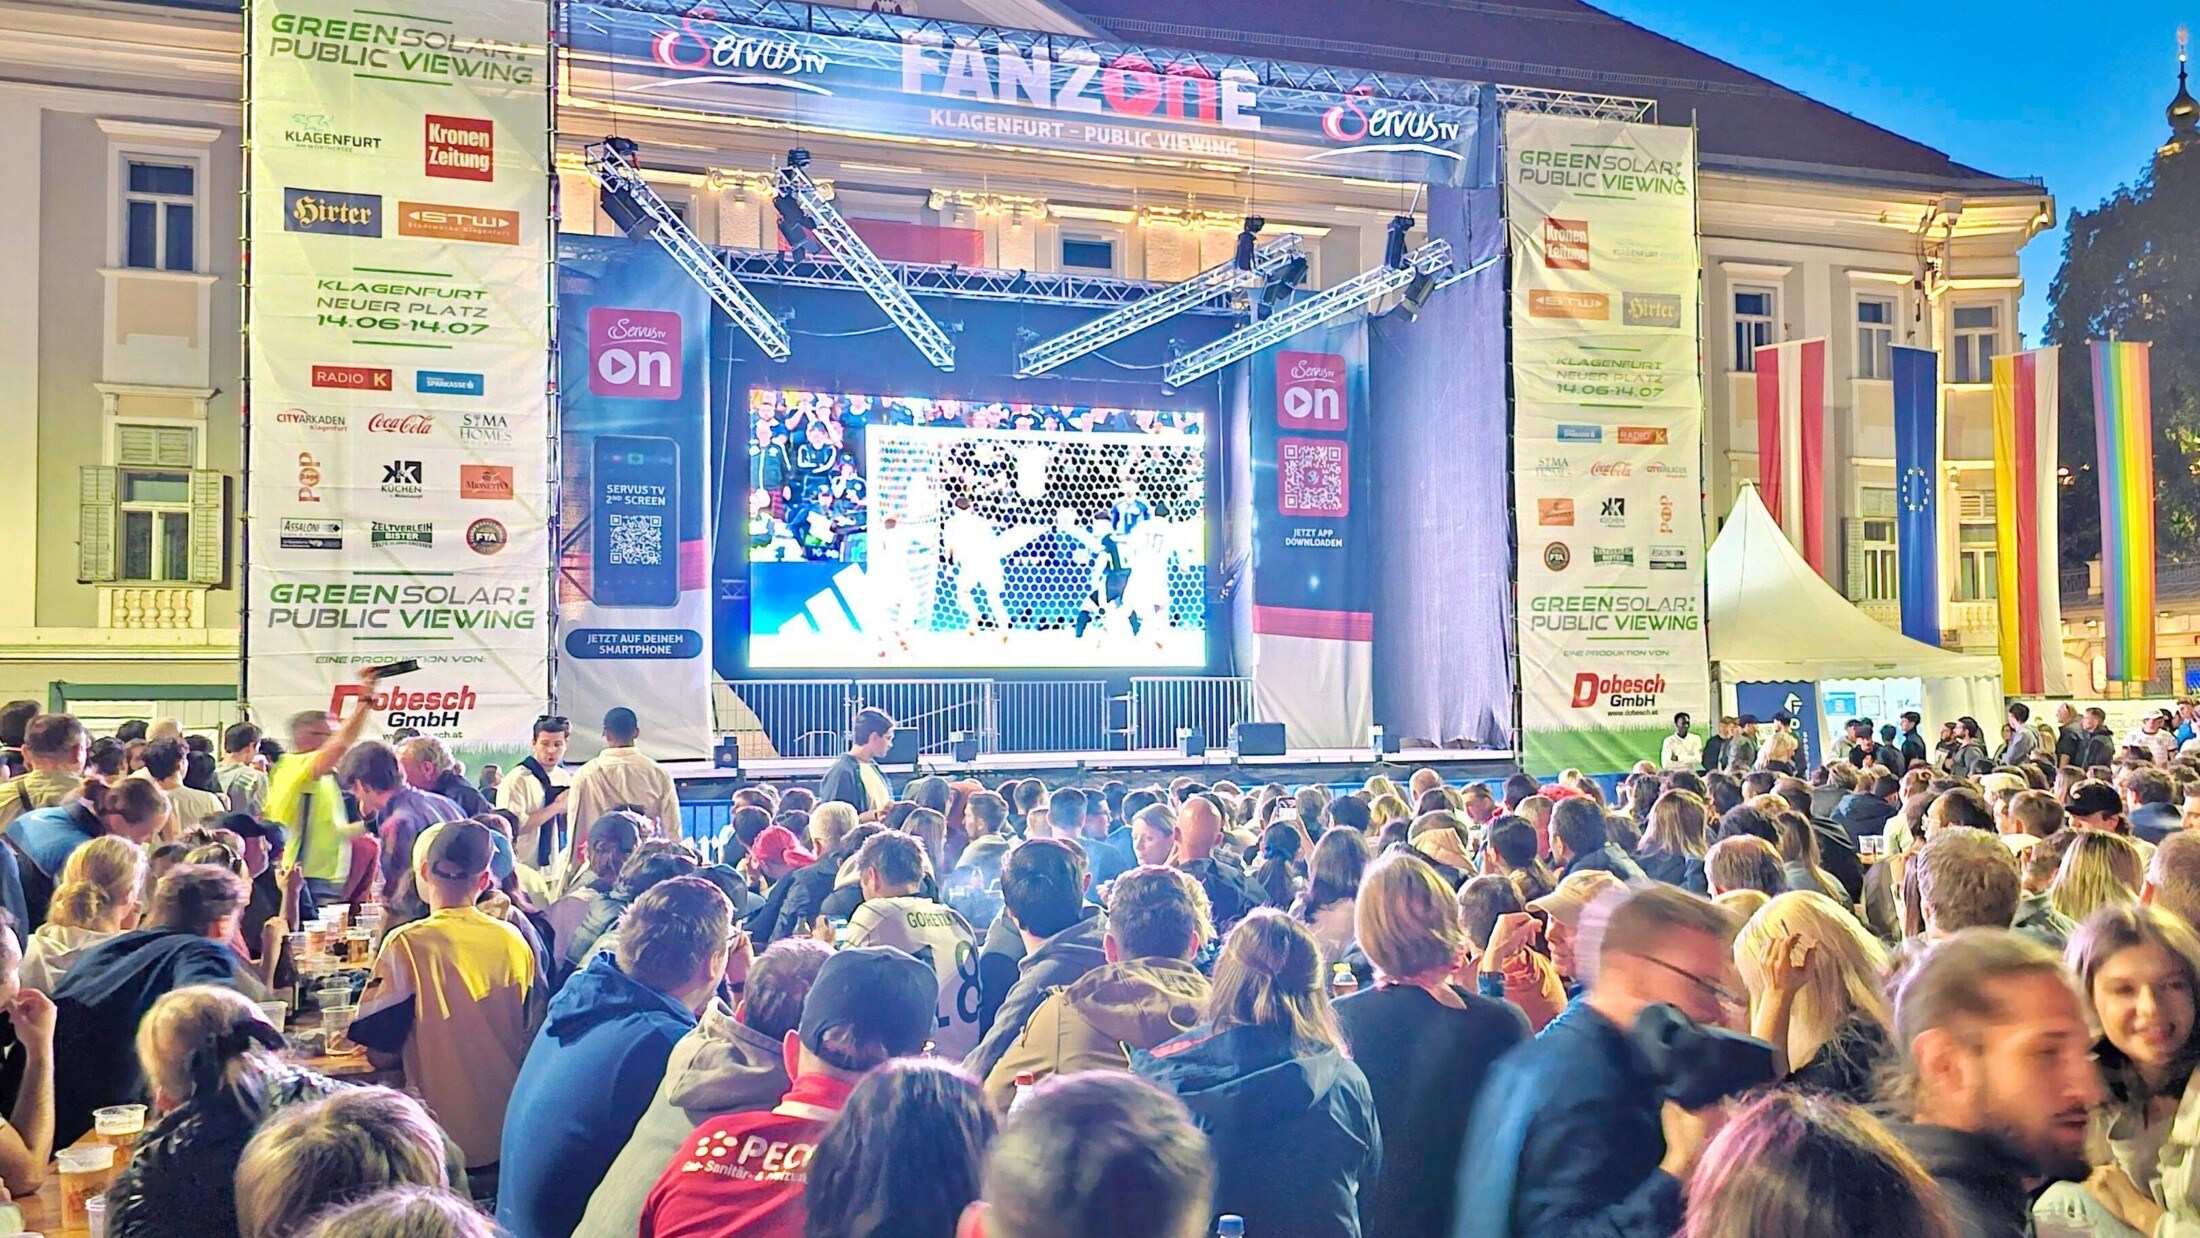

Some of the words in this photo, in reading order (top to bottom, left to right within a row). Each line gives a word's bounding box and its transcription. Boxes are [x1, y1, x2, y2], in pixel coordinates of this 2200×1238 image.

[269, 37, 390, 69] PUBLIC
[398, 51, 534, 85] VIEWING
[285, 130, 382, 149] KLAGENFURT
[429, 123, 490, 149] Kronen
[929, 108, 1064, 140] KLAGENFURT
[1084, 125, 1151, 149] PUBLIC
[1156, 133, 1239, 158] VIEWING
[429, 147, 490, 173] Zeitung
[1519, 168, 1597, 189] PUBLIC
[1601, 172, 1687, 196] VIEWING
[293, 194, 373, 228] Hirter
[1546, 224, 1586, 244] Kronen
[1546, 242, 1587, 263] Zeitung
[317, 279, 488, 300] KLAGENFURT
[316, 297, 401, 313] NEUER
[408, 302, 488, 319] PLATZ
[1628, 297, 1675, 319] Hirter
[1556, 357, 1663, 370] KLAGENFURT
[317, 371, 364, 385] RADIO
[372, 372, 387, 387] K
[1556, 370, 1609, 382] NEUER
[1613, 373, 1663, 384] PLATZ
[1620, 432, 1650, 441] RADIO
[1655, 430, 1665, 443] K
[381, 484, 422, 494] KÜCHEN
[606, 484, 649, 495] SERVUS
[650, 485, 666, 496] TV
[624, 495, 666, 506] SCREEN
[371, 520, 433, 532] ZELTVERLEIH
[1293, 528, 1316, 538] JETZT
[1317, 529, 1334, 538] APP
[385, 532, 419, 540] BISTER
[475, 532, 498, 542] FTA
[1285, 537, 1343, 548] DOWNLOADEN
[268, 608, 390, 629] PUBLIC
[399, 608, 536, 629] VIEWING
[1531, 615, 1609, 631] PUBLIC
[1614, 615, 1698, 631] VIEWING
[587, 633, 618, 645] JETZT
[620, 633, 641, 644] AUF
[640, 633, 684, 644] DEINEM
[599, 644, 672, 655] SMARTPHONE
[315, 655, 348, 664] EINE
[1571, 672, 1666, 708] Dobesch
[1610, 694, 1656, 708] GmbH
[387, 711, 460, 727] GmbH
